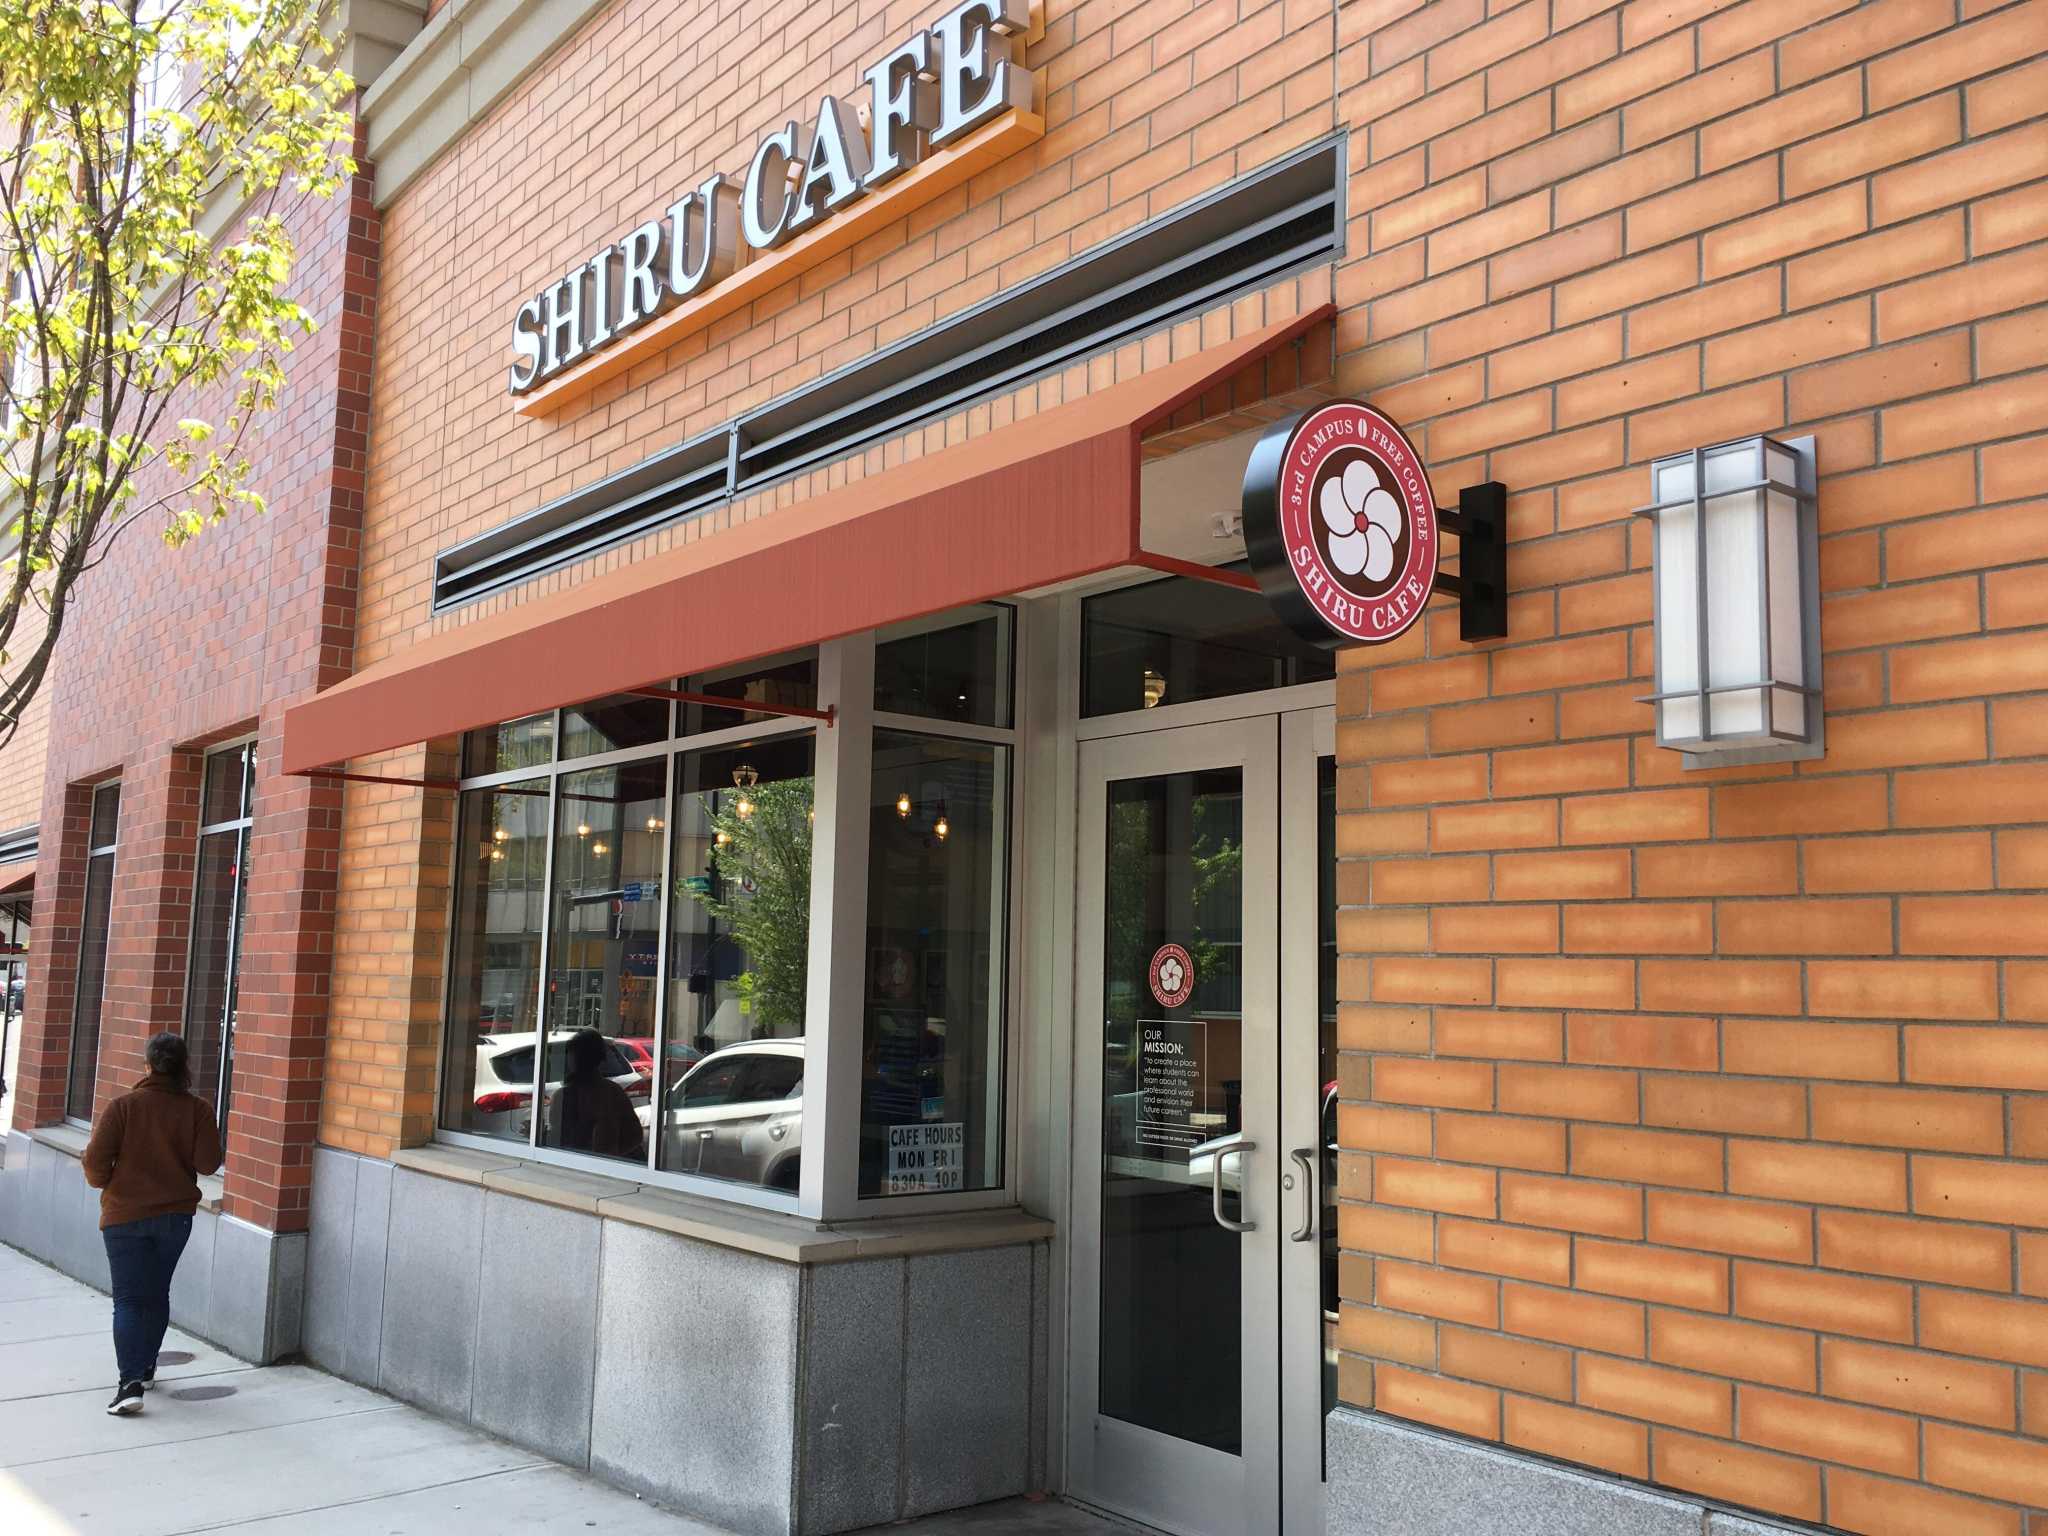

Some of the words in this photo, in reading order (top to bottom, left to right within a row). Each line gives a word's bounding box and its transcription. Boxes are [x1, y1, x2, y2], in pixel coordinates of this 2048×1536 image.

[509, 172, 728, 396] SHIRU
[741, 0, 1006, 250] CAFE
[1291, 470, 1305, 505] 3rd
[1300, 419, 1353, 467] CAMPUS
[1371, 426, 1404, 467] FREE
[1402, 466, 1428, 541] COFFEE
[1293, 545, 1365, 628] SHIRU
[1372, 574, 1424, 631] CAFE
[1144, 1029, 1162, 1040] OUR
[1154, 1058, 1173, 1066] create
[1179, 1059, 1197, 1068] place
[1144, 1066, 1161, 1074] where
[1162, 1067, 1186, 1077] students
[1187, 1070, 1200, 1078] can
[1159, 1078, 1177, 1086] about
[1144, 1096, 1156, 1104] and
[1144, 1104, 1160, 1113] future
[891, 1129, 919, 1147] CAFE
[925, 1127, 961, 1144] HOURS
[897, 1151, 925, 1169] MON
[933, 1149, 955, 1166] FRI
[935, 1171, 958, 1189] 10P
